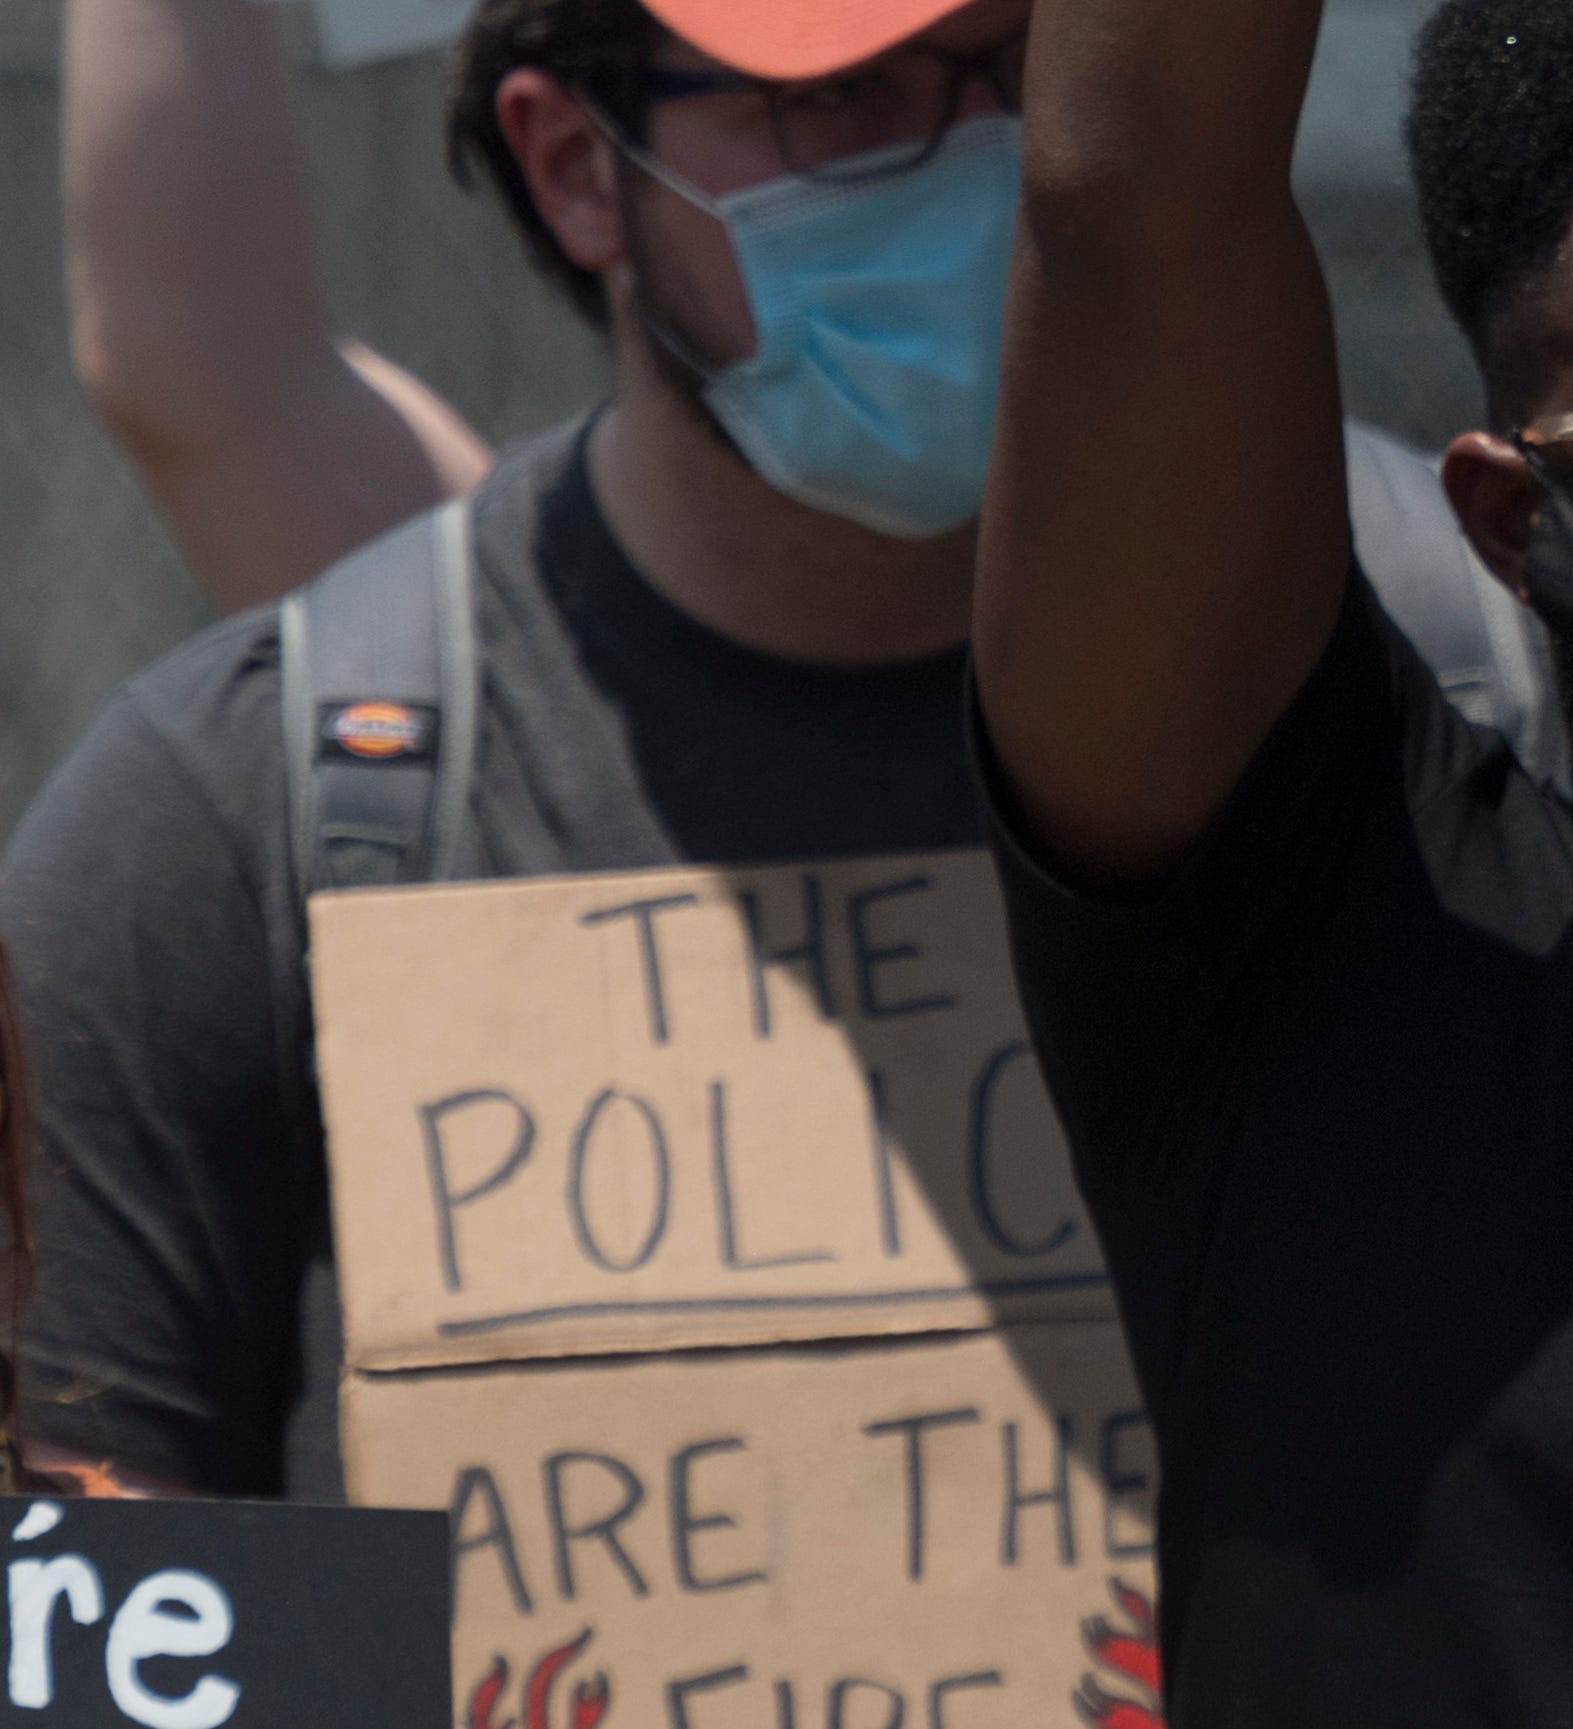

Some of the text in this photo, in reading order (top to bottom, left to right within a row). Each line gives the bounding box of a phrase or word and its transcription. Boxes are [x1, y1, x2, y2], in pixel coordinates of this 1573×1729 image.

[580, 876, 955, 1044] THE
[451, 1407, 1159, 1615] ARE THE
